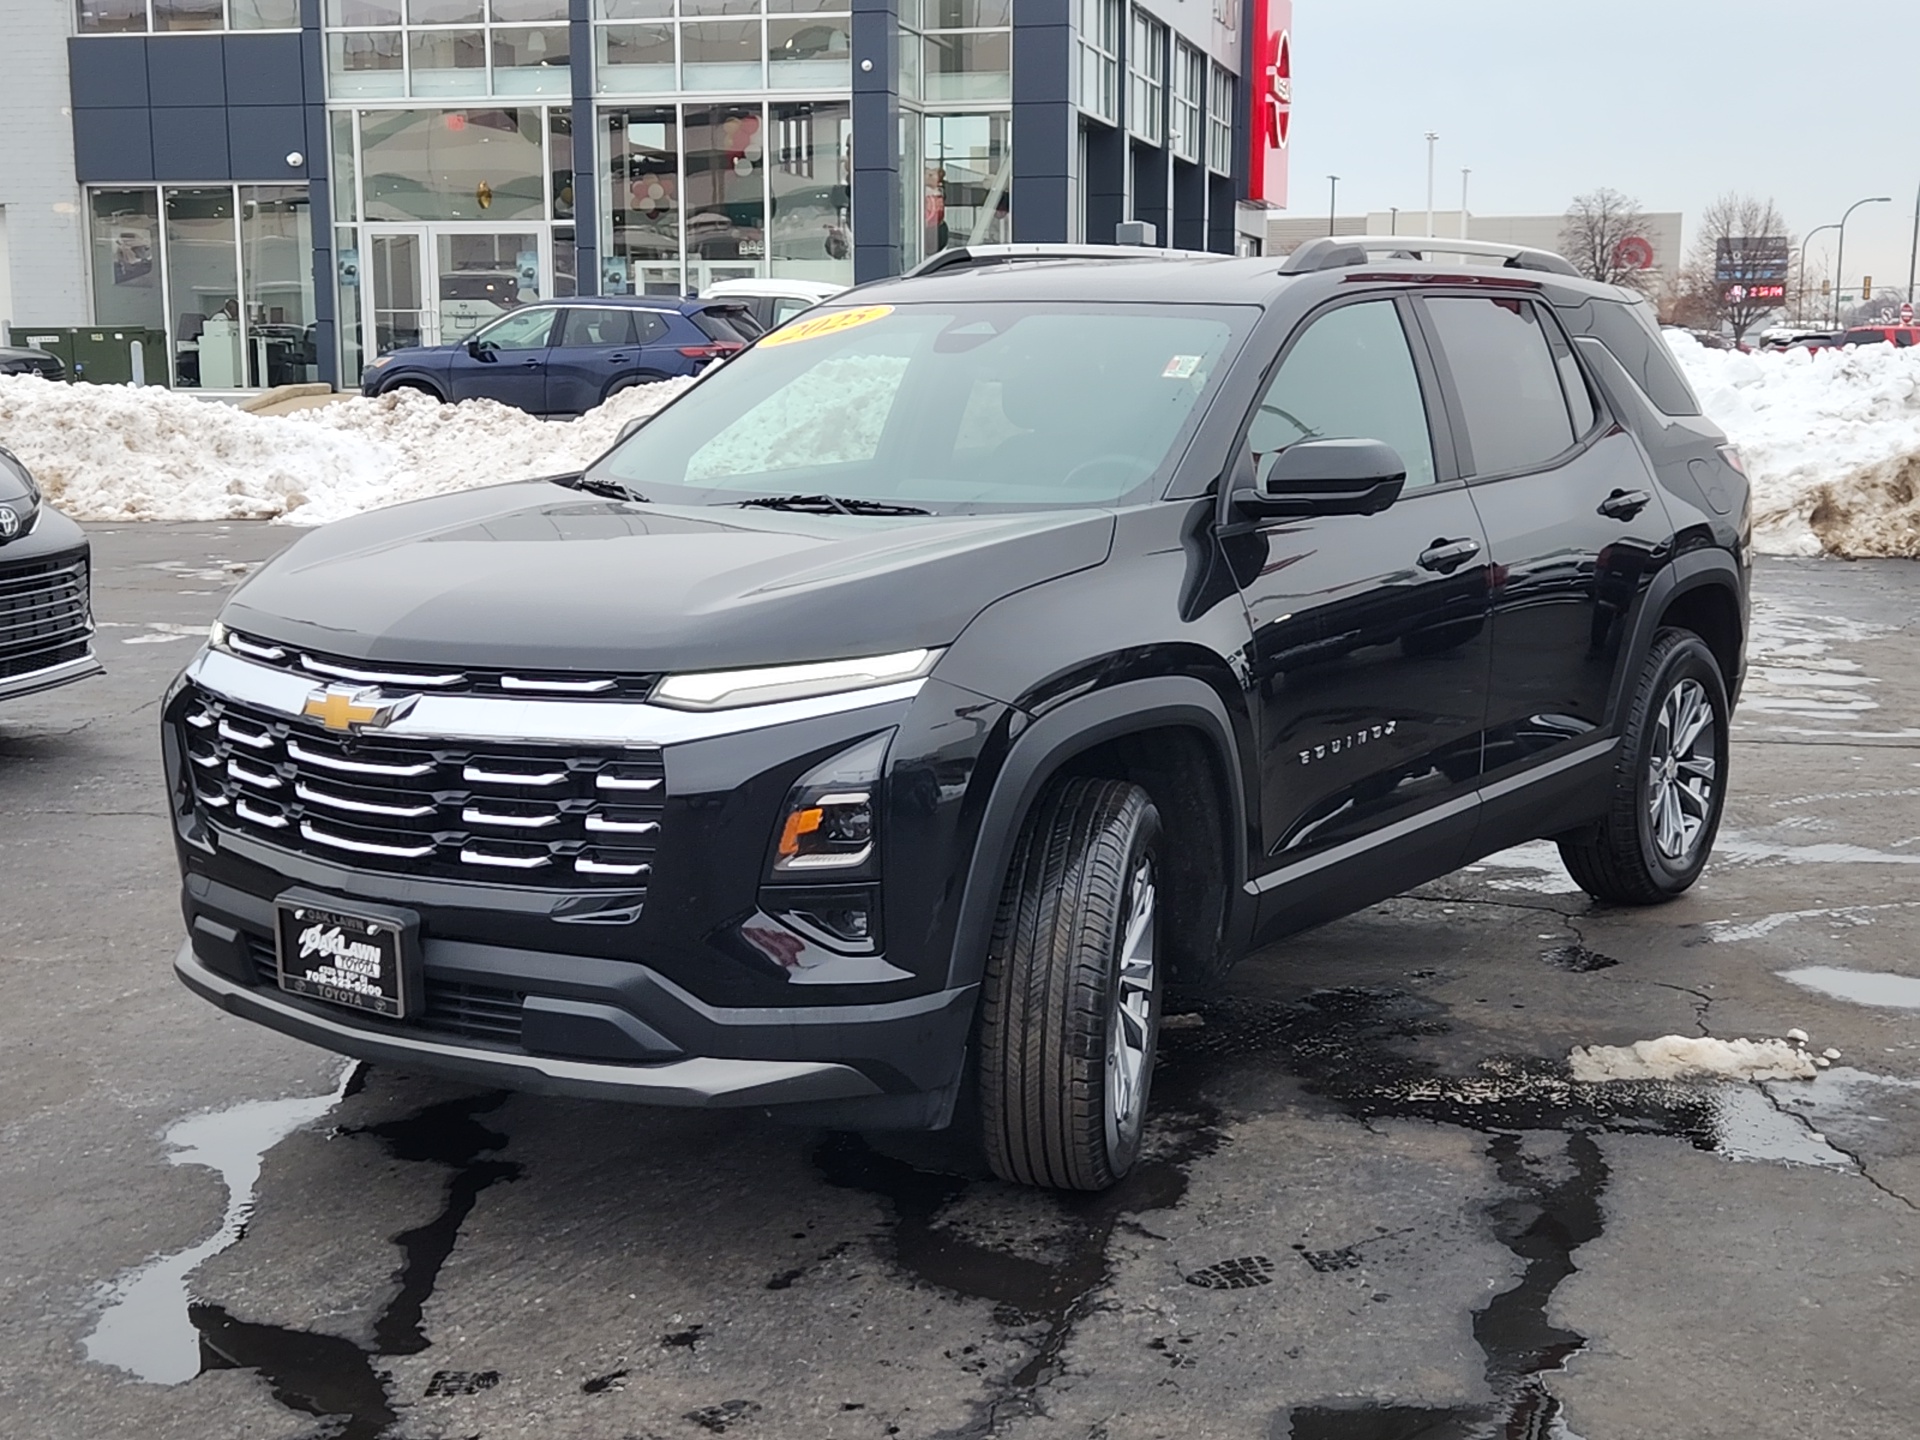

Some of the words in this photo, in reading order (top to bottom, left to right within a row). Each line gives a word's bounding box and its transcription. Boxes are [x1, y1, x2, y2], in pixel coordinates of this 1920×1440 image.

[776, 307, 878, 343] 2025
[1298, 720, 1397, 765] EQUINOX
[307, 909, 331, 923] OAK
[332, 914, 364, 930] LAWN
[340, 957, 375, 976] TOYOTA
[317, 984, 363, 1006] TOYOTA
